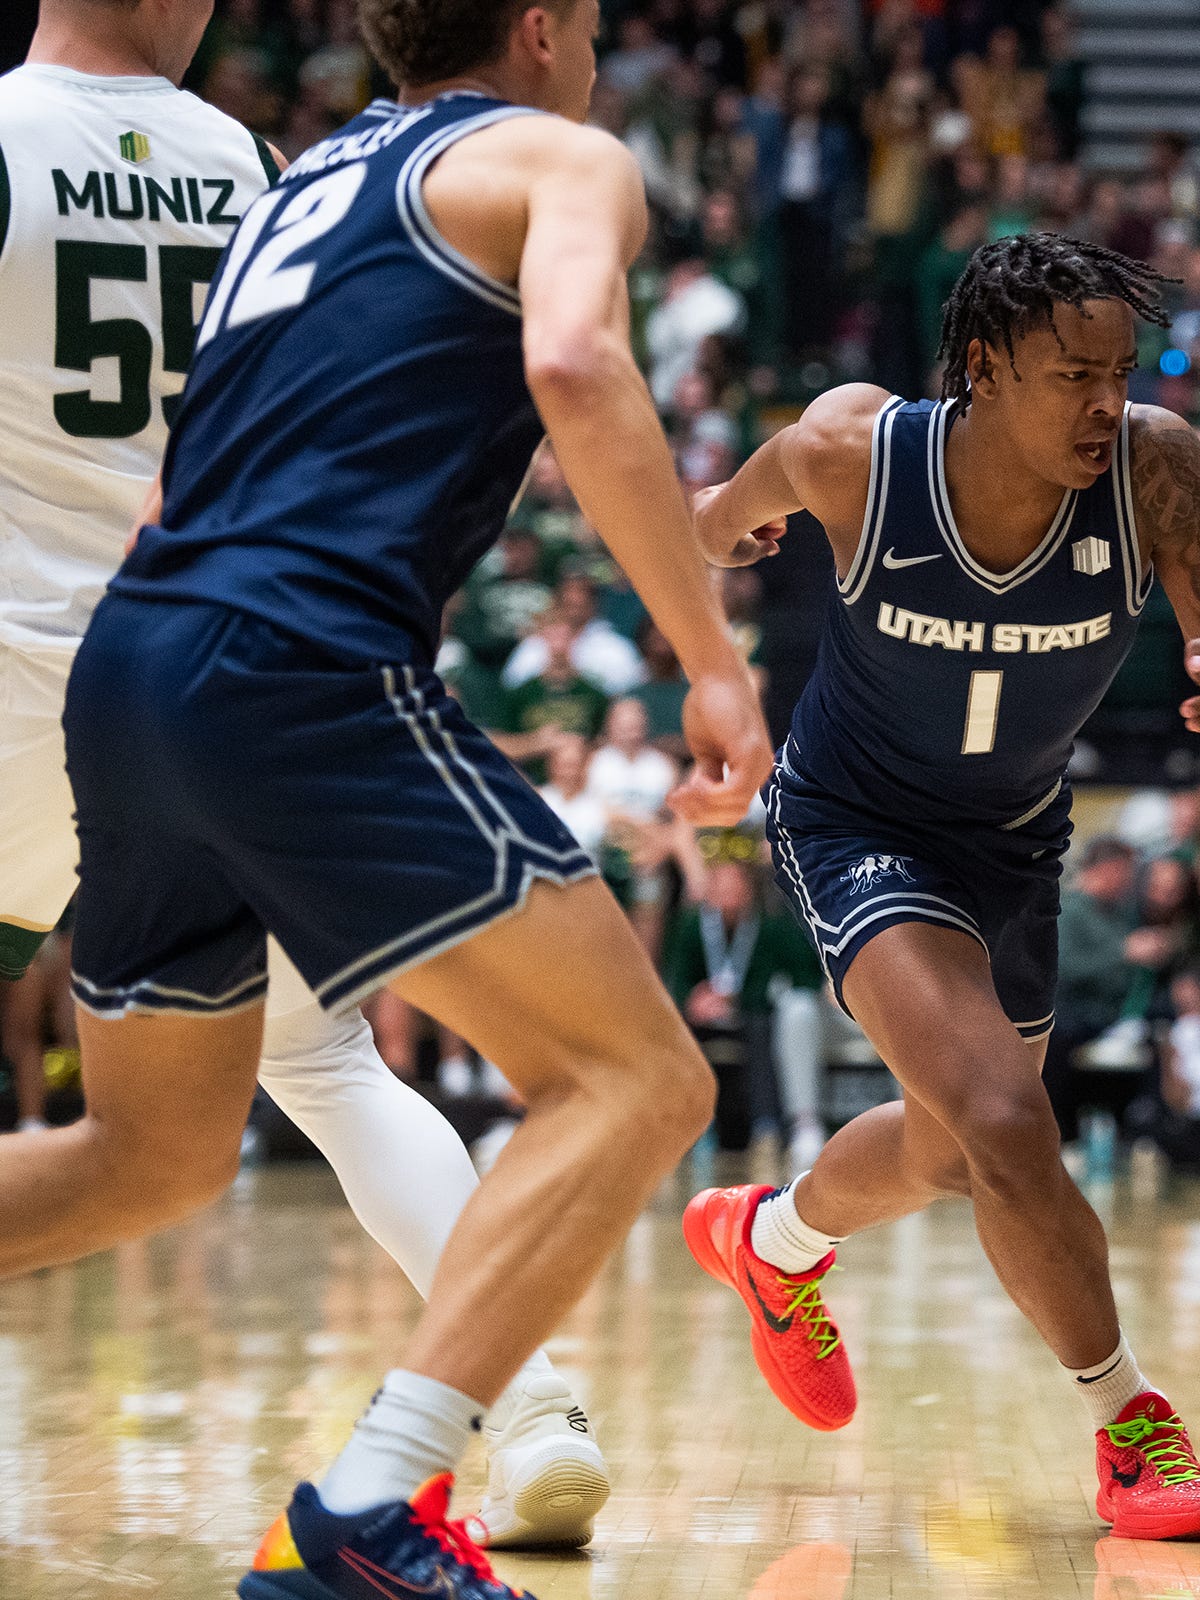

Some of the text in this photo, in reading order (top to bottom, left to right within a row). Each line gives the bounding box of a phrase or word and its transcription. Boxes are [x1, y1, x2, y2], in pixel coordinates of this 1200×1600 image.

[52, 168, 241, 224] MUNIZ
[196, 161, 368, 352] 12
[877, 601, 1112, 653] UTAH STATE
[960, 669, 1003, 755] 1
